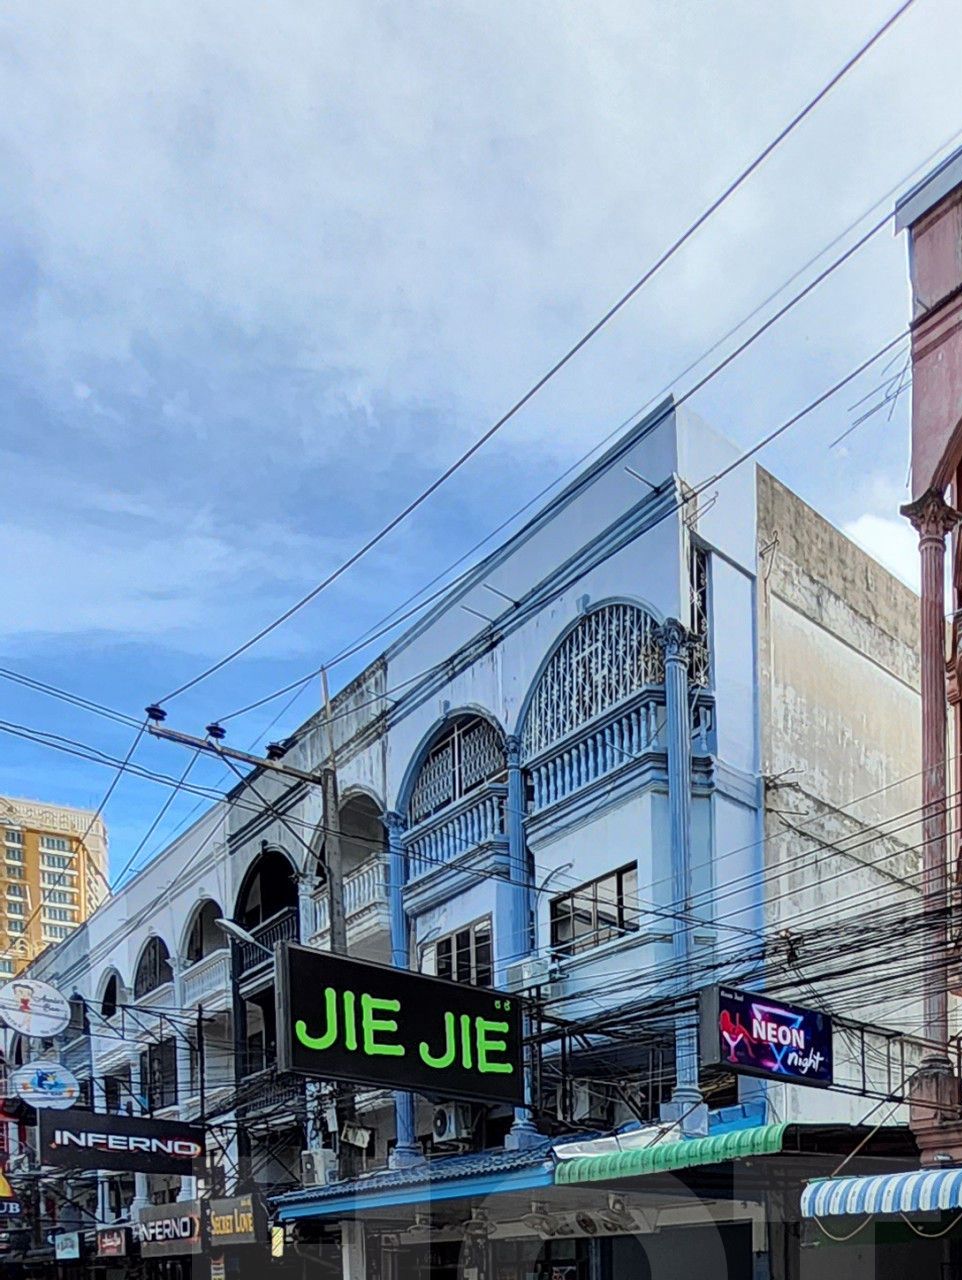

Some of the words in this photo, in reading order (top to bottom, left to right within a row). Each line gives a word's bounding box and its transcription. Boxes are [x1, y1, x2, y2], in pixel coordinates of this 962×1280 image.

[296, 987, 405, 1056] JIE
[419, 1011, 513, 1073] JIE
[752, 1018, 805, 1049] NEON
[787, 1047, 824, 1074] night
[54, 1130, 199, 1155] INFERNO
